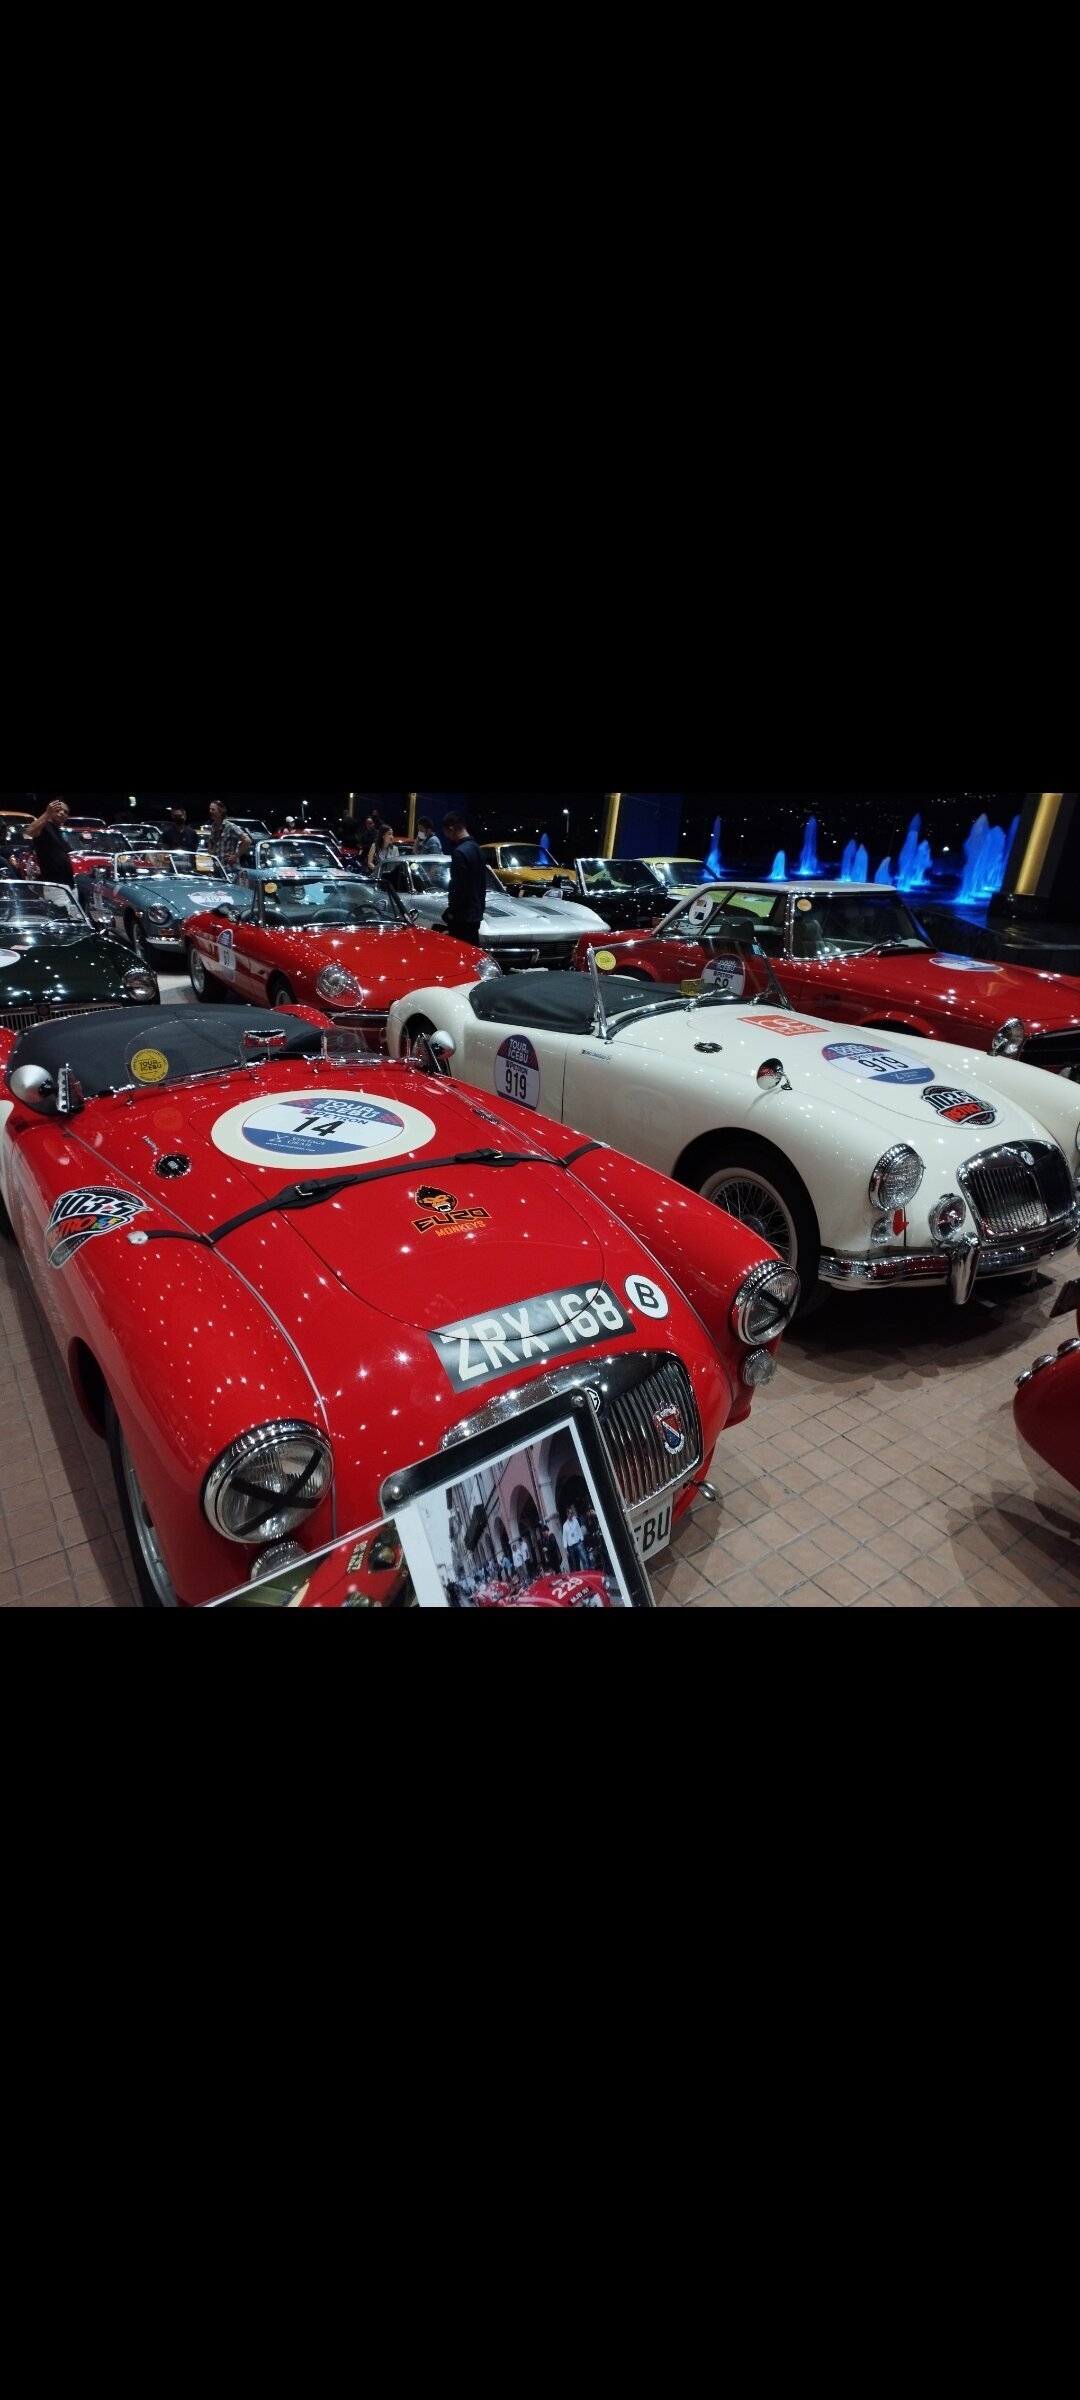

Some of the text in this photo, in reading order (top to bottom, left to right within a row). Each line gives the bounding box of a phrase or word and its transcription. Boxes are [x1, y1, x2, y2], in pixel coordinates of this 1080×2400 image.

[509, 1038, 527, 1053] TOUR
[510, 1049, 529, 1064] CEBU
[858, 1056, 909, 1073] 919
[505, 1068, 527, 1100] 919
[323, 1105, 378, 1118] CEBU
[324, 1099, 374, 1113] TOUR
[943, 1103, 981, 1122] RETRO
[293, 1116, 345, 1137] 14
[312, 1111, 369, 1125] PETRON
[434, 1220, 486, 1237] MONKEYS
[634, 1281, 660, 1309] B
[441, 1287, 624, 1382] ZRX 168
